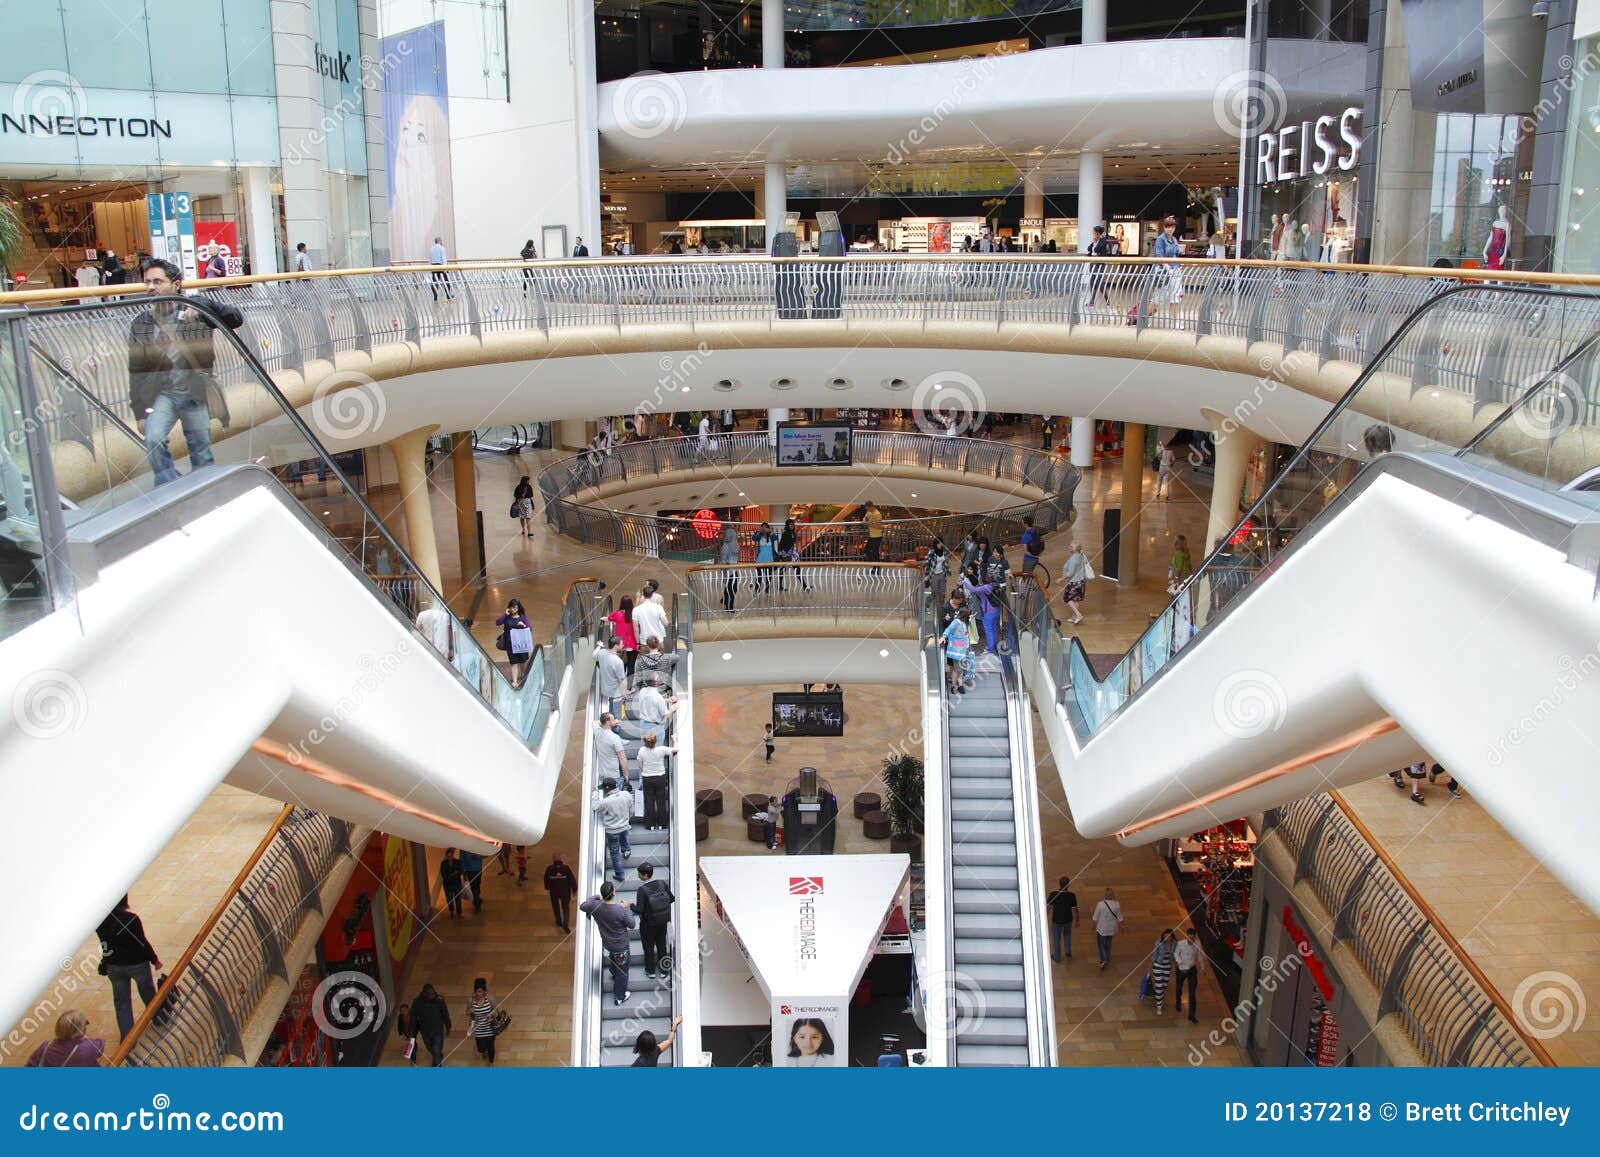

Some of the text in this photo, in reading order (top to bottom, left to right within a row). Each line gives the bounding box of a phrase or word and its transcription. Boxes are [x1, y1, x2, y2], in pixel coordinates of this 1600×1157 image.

[1, 113, 172, 139] NNECTION
[1257, 107, 1362, 184] REISS
[177, 195, 190, 214] 3
